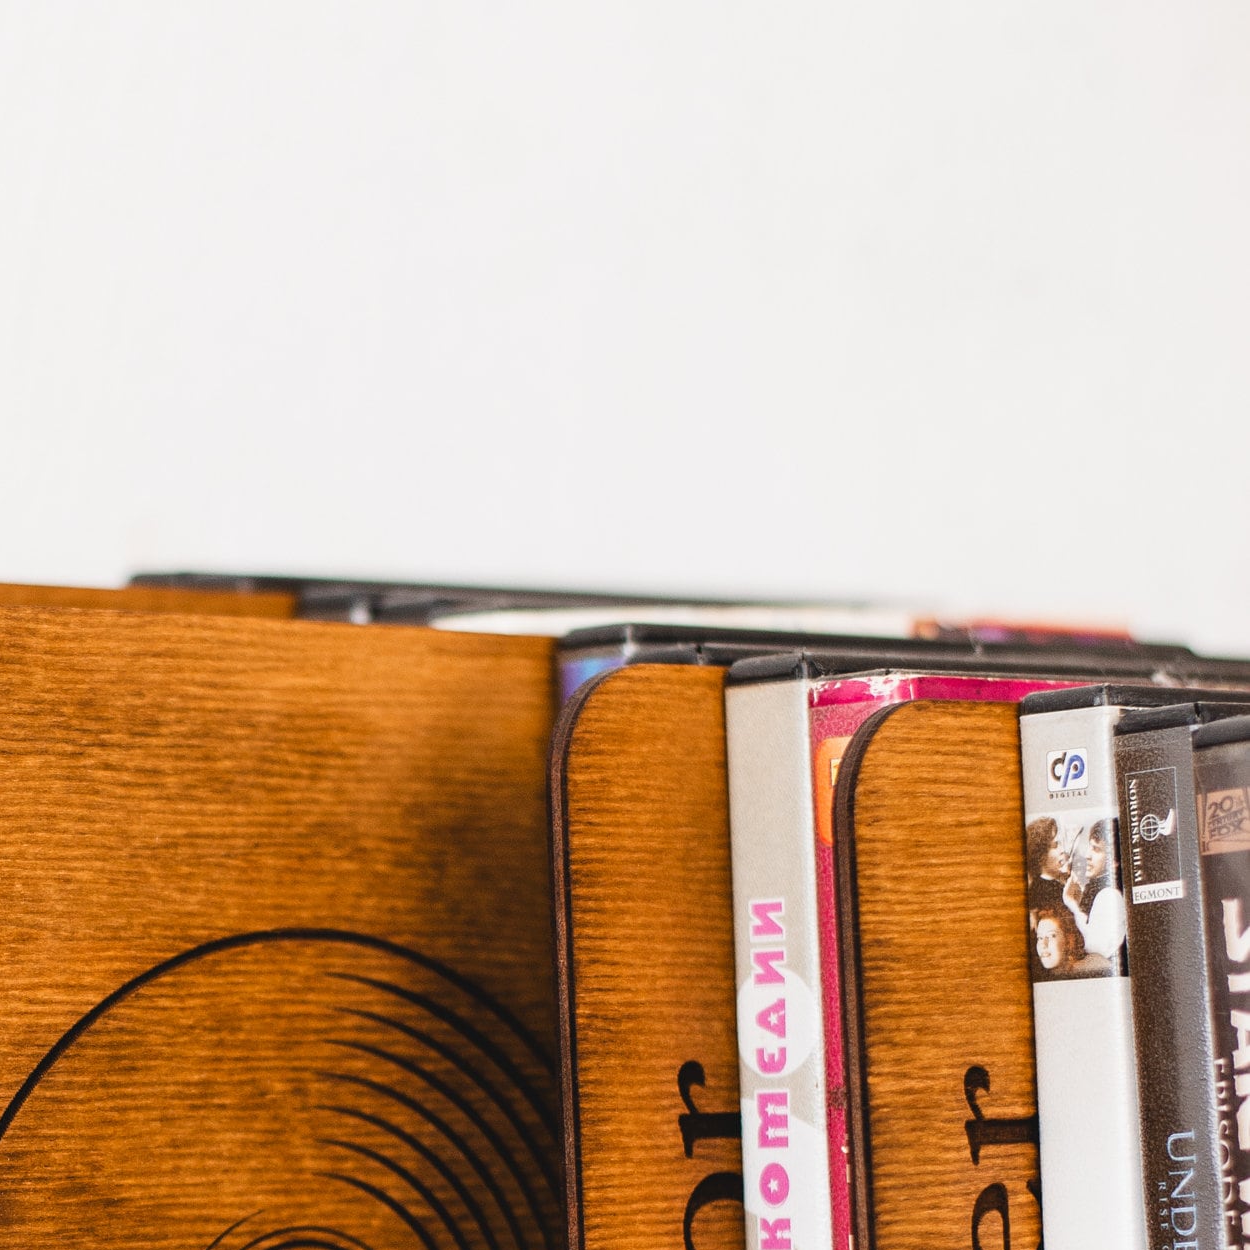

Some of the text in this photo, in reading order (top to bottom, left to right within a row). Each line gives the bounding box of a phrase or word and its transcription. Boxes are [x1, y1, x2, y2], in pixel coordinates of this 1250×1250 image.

[1129, 779, 1143, 882] NORDISK FILM
[1134, 886, 1181, 901] EGMONT
[1157, 1181, 1169, 1231] RISE
